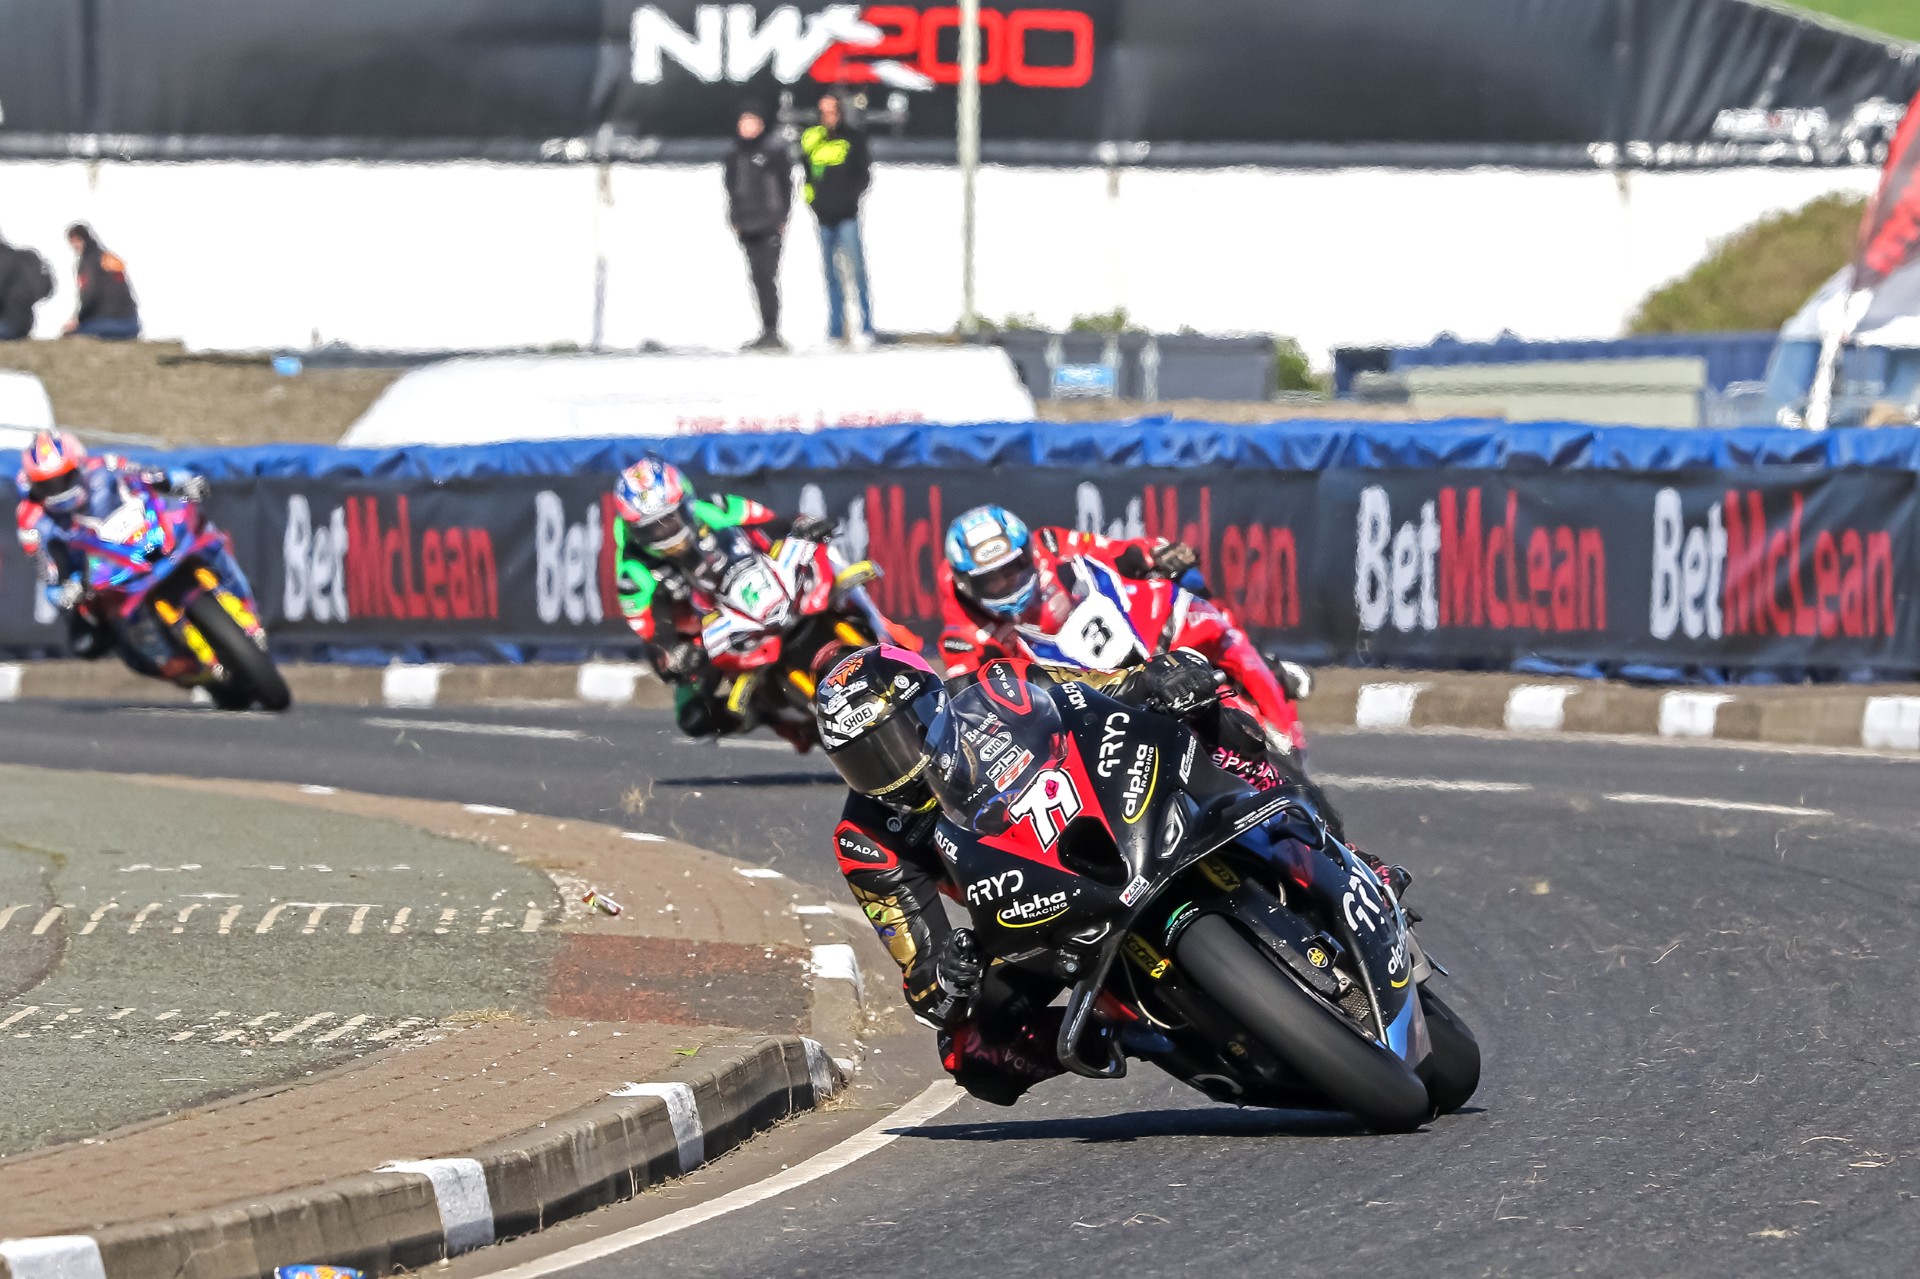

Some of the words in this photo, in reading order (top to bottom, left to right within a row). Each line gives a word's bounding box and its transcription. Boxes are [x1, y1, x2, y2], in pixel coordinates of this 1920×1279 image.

[283, 493, 499, 623] BetMcLean
[1356, 485, 1608, 633] BetMcLean
[1650, 486, 1896, 641] BetMcLean
[1081, 615, 1114, 658] 3
[992, 663, 1017, 698] SPADA
[843, 708, 873, 731] SHOEI
[1096, 711, 1131, 778] GRYD
[1122, 743, 1149, 817] alpha
[1141, 746, 1155, 788] RACING
[839, 837, 880, 858] SPADA
[967, 869, 1024, 907] GRYD
[1001, 890, 1067, 919] alpha
[1028, 901, 1069, 919] RACING
